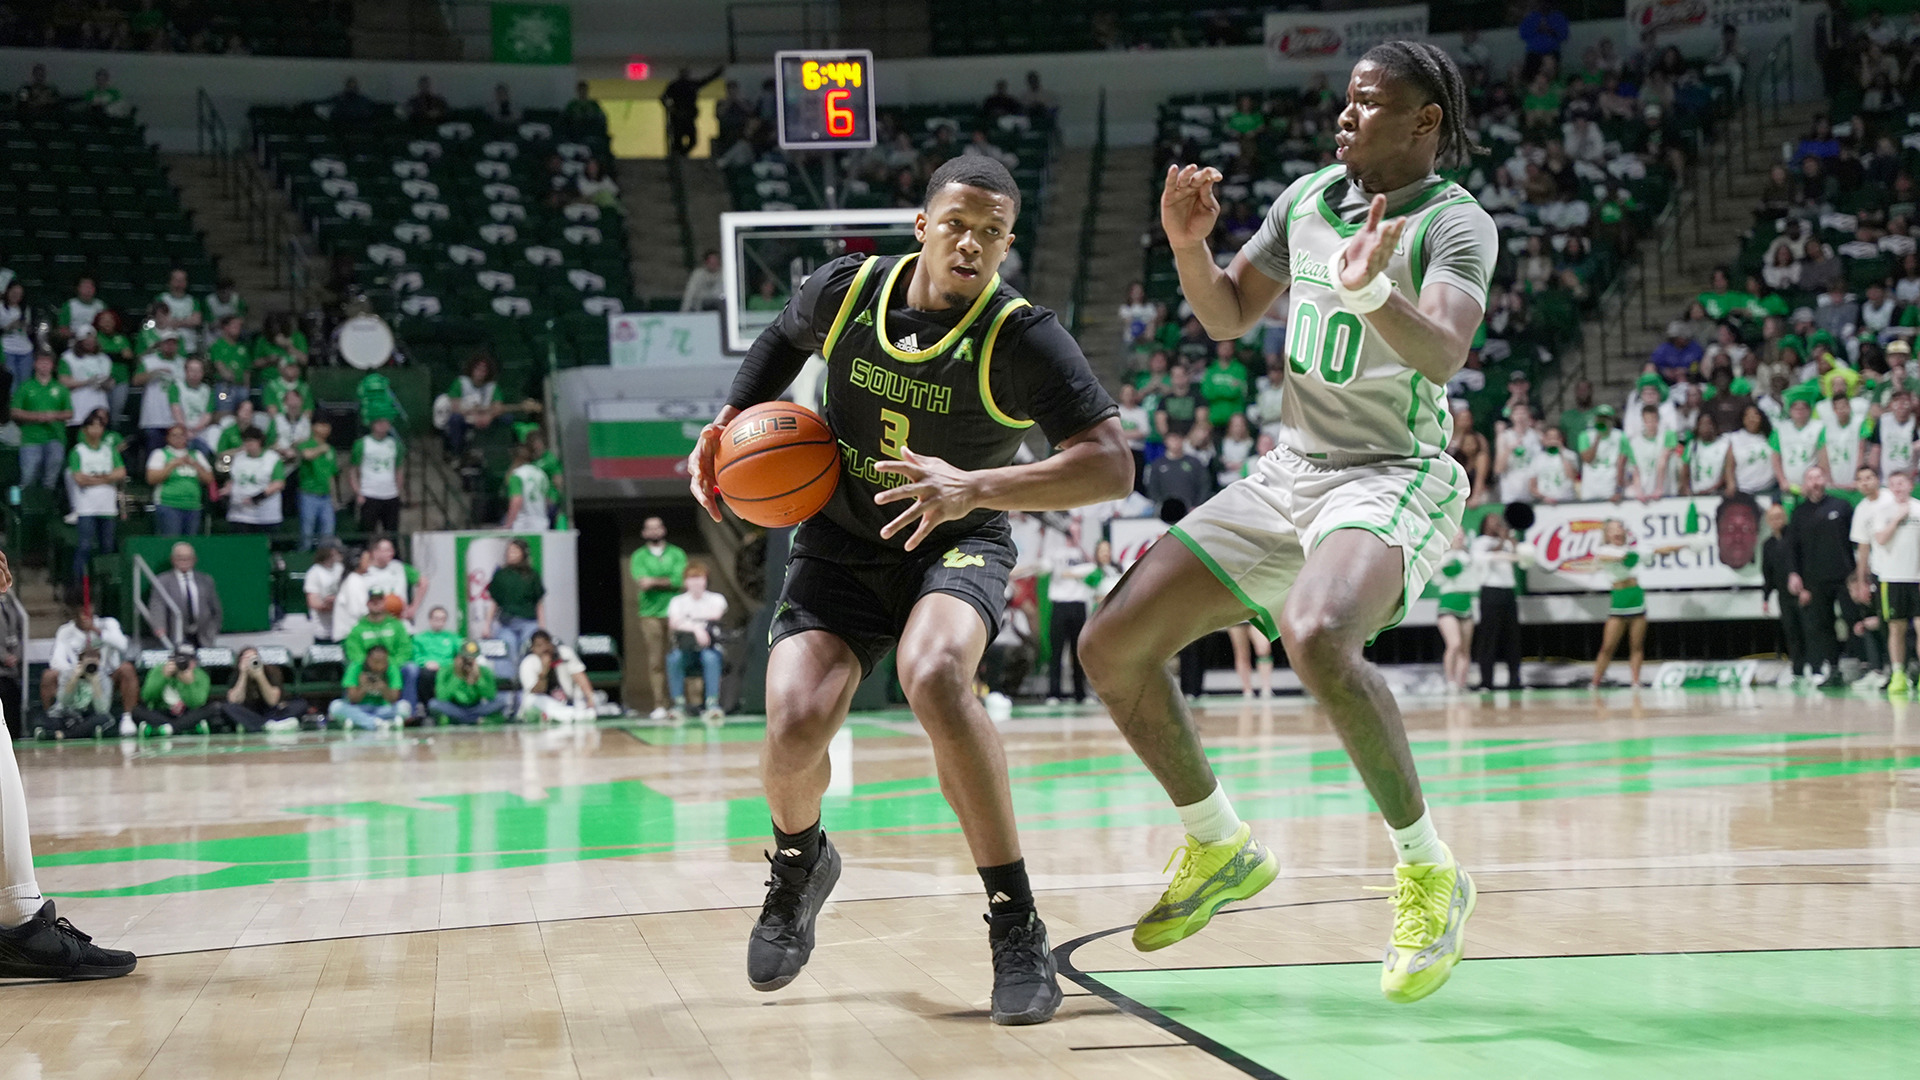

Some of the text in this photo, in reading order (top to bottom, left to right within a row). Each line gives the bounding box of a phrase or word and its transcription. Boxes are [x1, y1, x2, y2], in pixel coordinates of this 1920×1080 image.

[802, 60, 862, 90] 6:44
[825, 88, 855, 137] 6
[1289, 300, 1366, 389] 00
[850, 357, 952, 414] SOUTH
[732, 416, 798, 446] ELITE
[879, 407, 910, 462] 3
[1643, 513, 1712, 538] STUD
